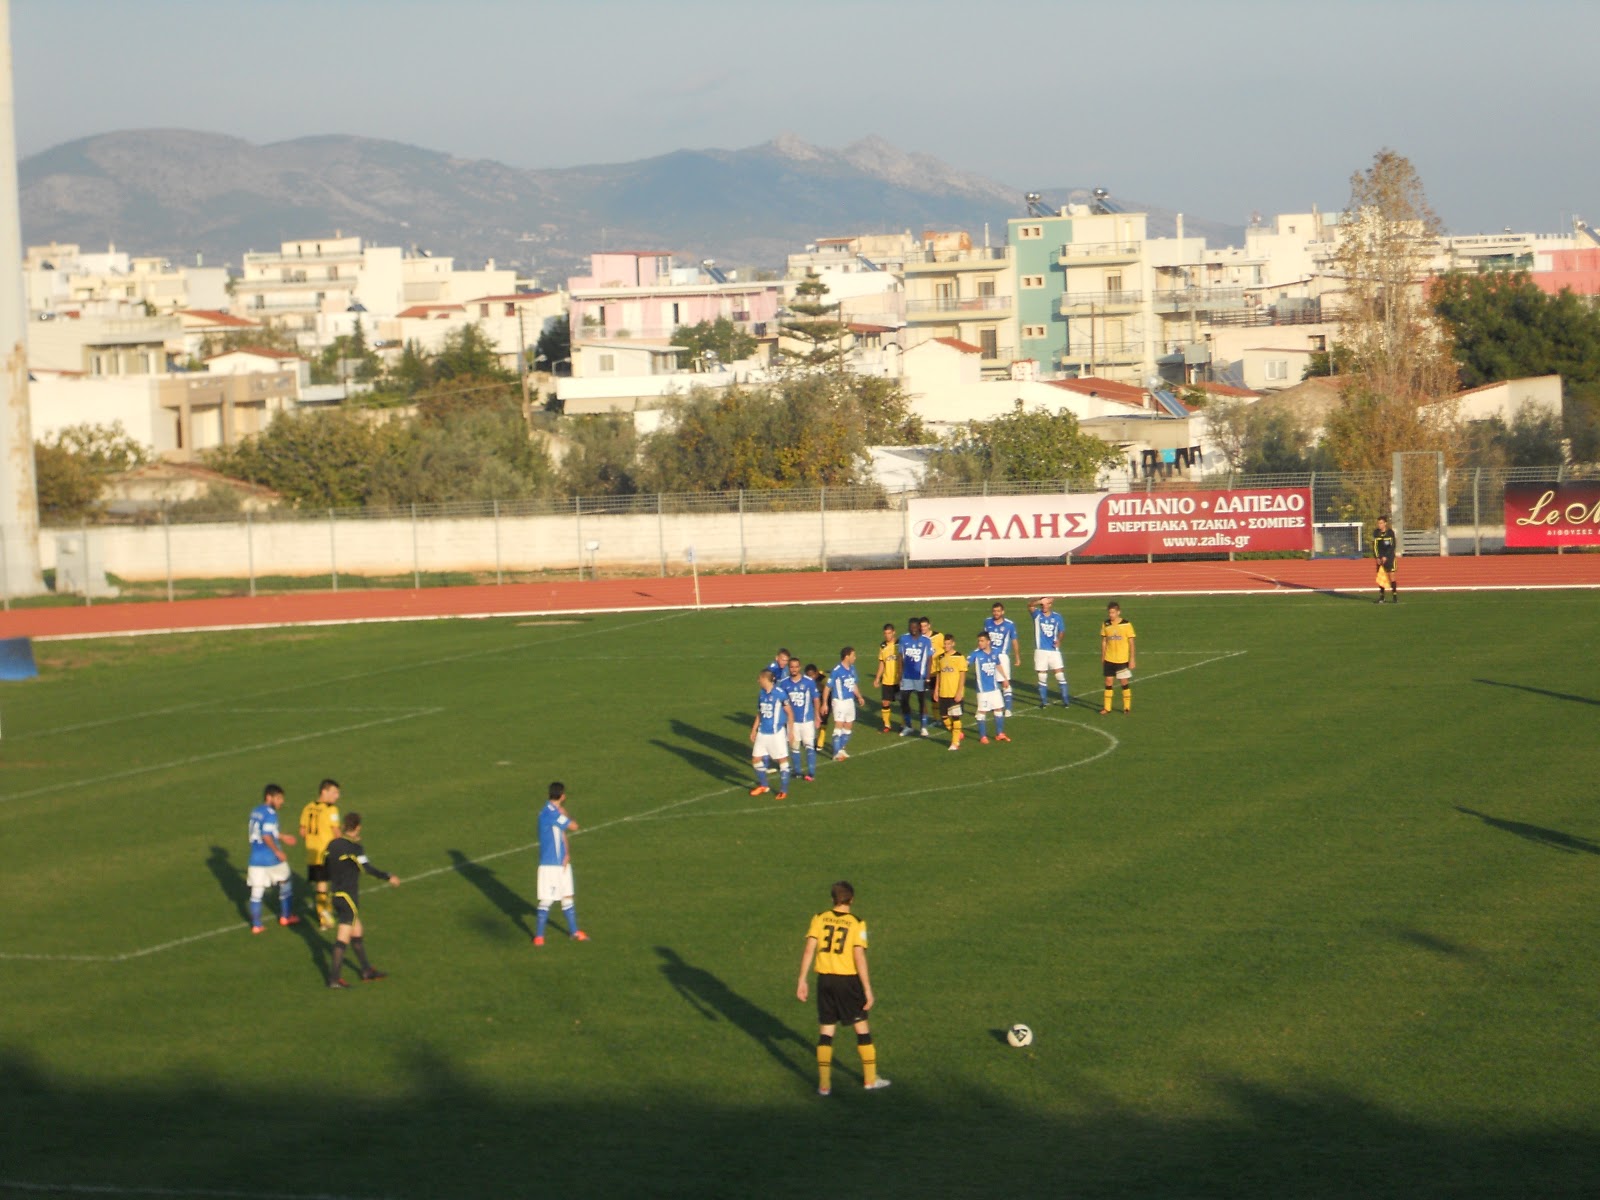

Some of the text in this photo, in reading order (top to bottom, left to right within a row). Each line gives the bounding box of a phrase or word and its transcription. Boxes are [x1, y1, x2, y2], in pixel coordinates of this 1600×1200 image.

[1107, 494, 1305, 516] ΜΠΑΝΙΟ ΔΑΠΕΔΟ
[1516, 490, 1560, 525] Le
[951, 513, 1088, 541] ΖΑΛΗΣ
[1108, 516, 1306, 532] ΕΝΕΡΓΕΙΑΚΑ ΤΖΑΚΙΑ ΣΟΜΠΕΣ
[1163, 533, 1251, 548] www.zalis.gr
[820, 924, 848, 954] 33
